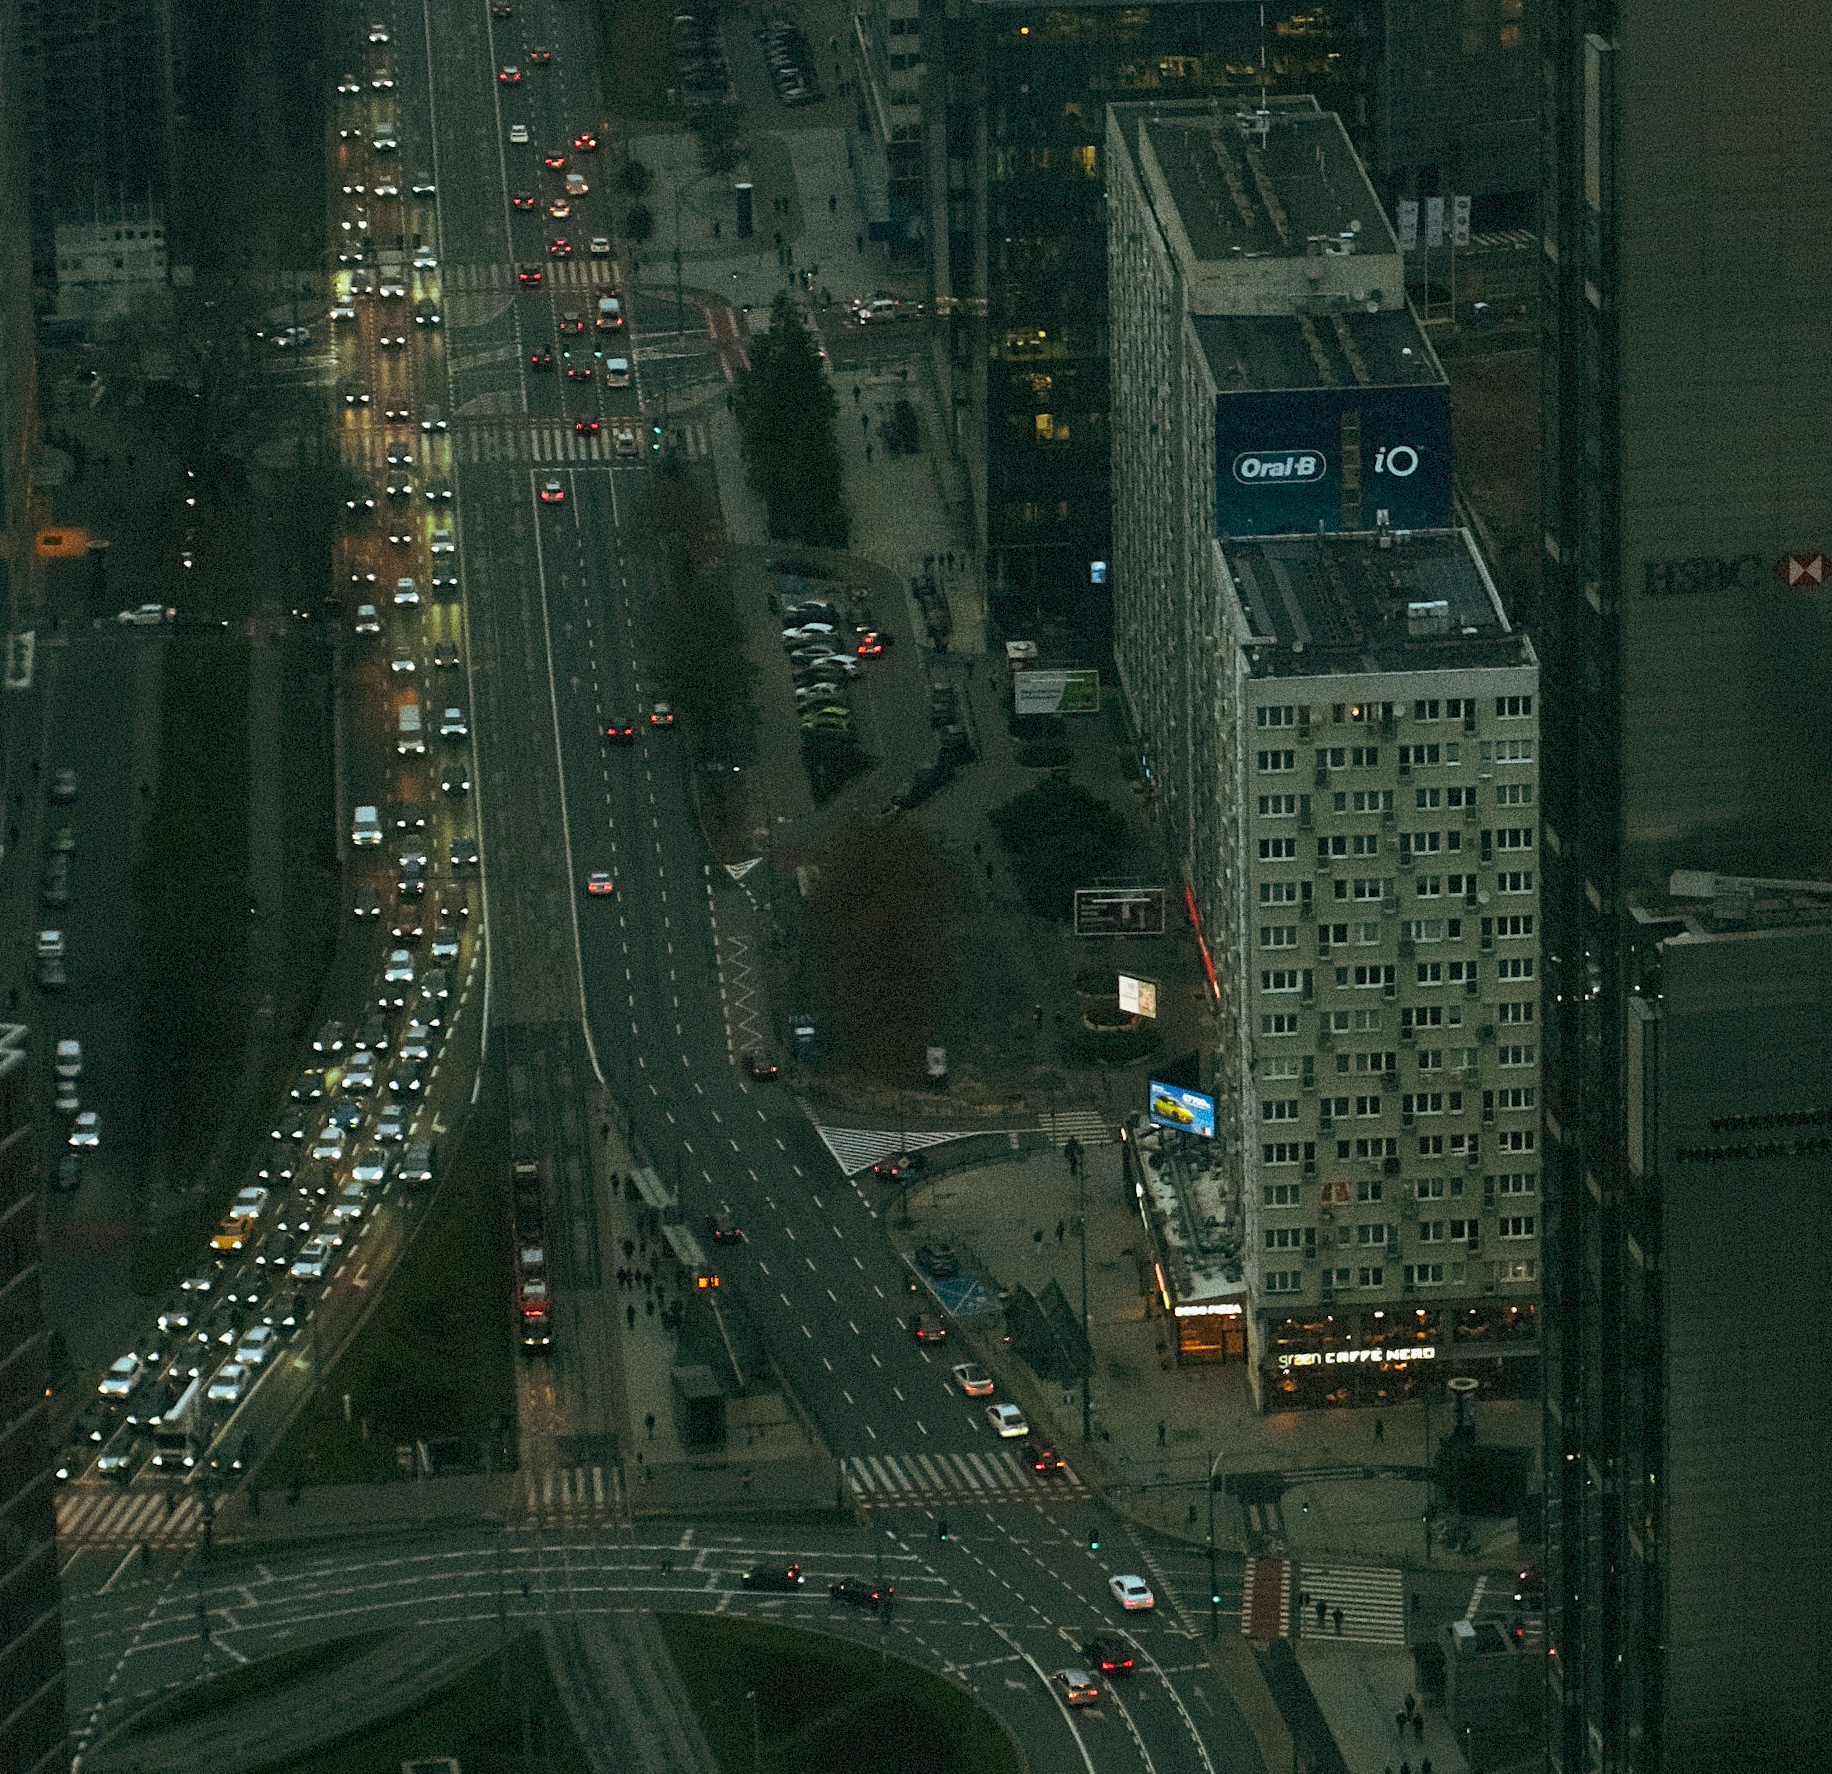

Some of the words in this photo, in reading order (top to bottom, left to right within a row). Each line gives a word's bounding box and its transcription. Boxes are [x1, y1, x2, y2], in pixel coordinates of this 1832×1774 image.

[1240, 456, 1316, 478] Oral-B
[1374, 445, 1419, 477] iO
[1643, 553, 1762, 595] HSBC
[1278, 1353, 1321, 1369] green
[1386, 1347, 1435, 1361] NERO
